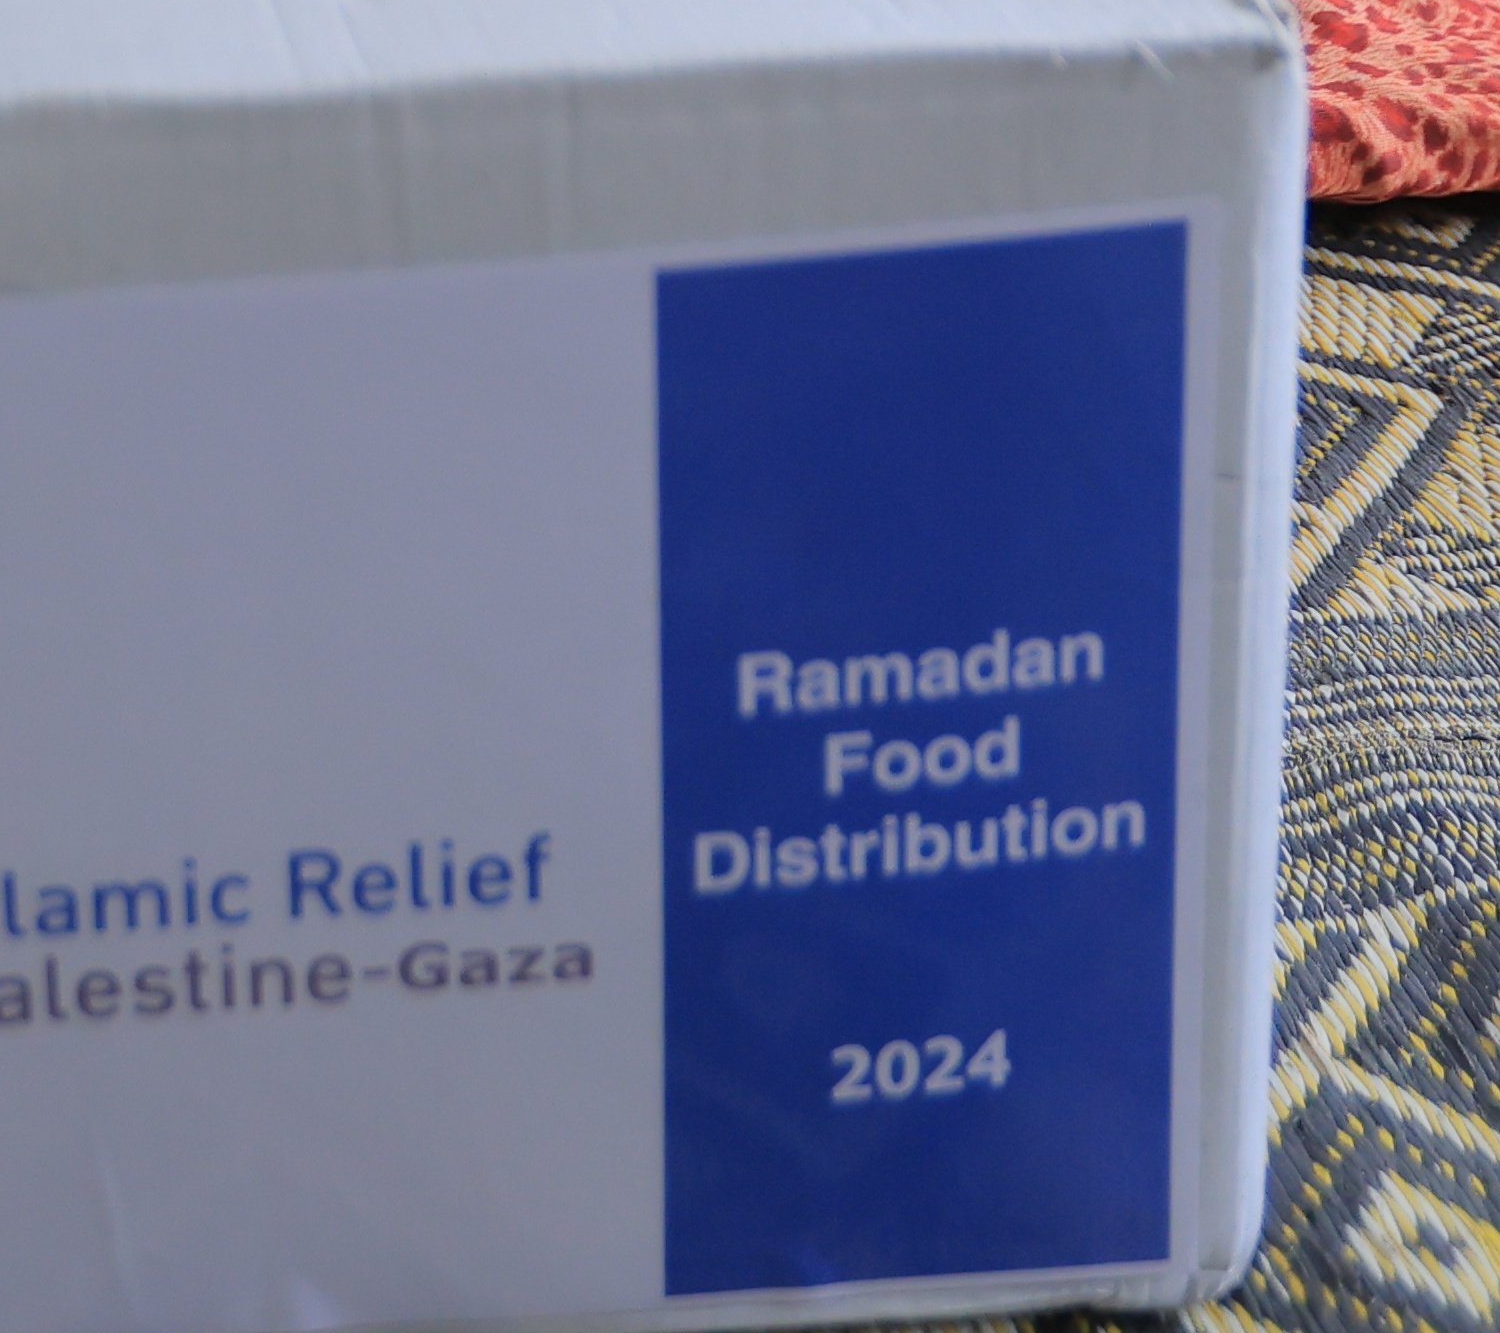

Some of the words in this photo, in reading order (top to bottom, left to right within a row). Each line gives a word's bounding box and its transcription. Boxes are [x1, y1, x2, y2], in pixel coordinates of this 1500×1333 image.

[737, 627, 1107, 721] Ramadan
[823, 714, 1022, 799] Food
[286, 831, 553, 920] Relief
[693, 796, 1148, 897] Distribution
[830, 1027, 1013, 1106] 2024
